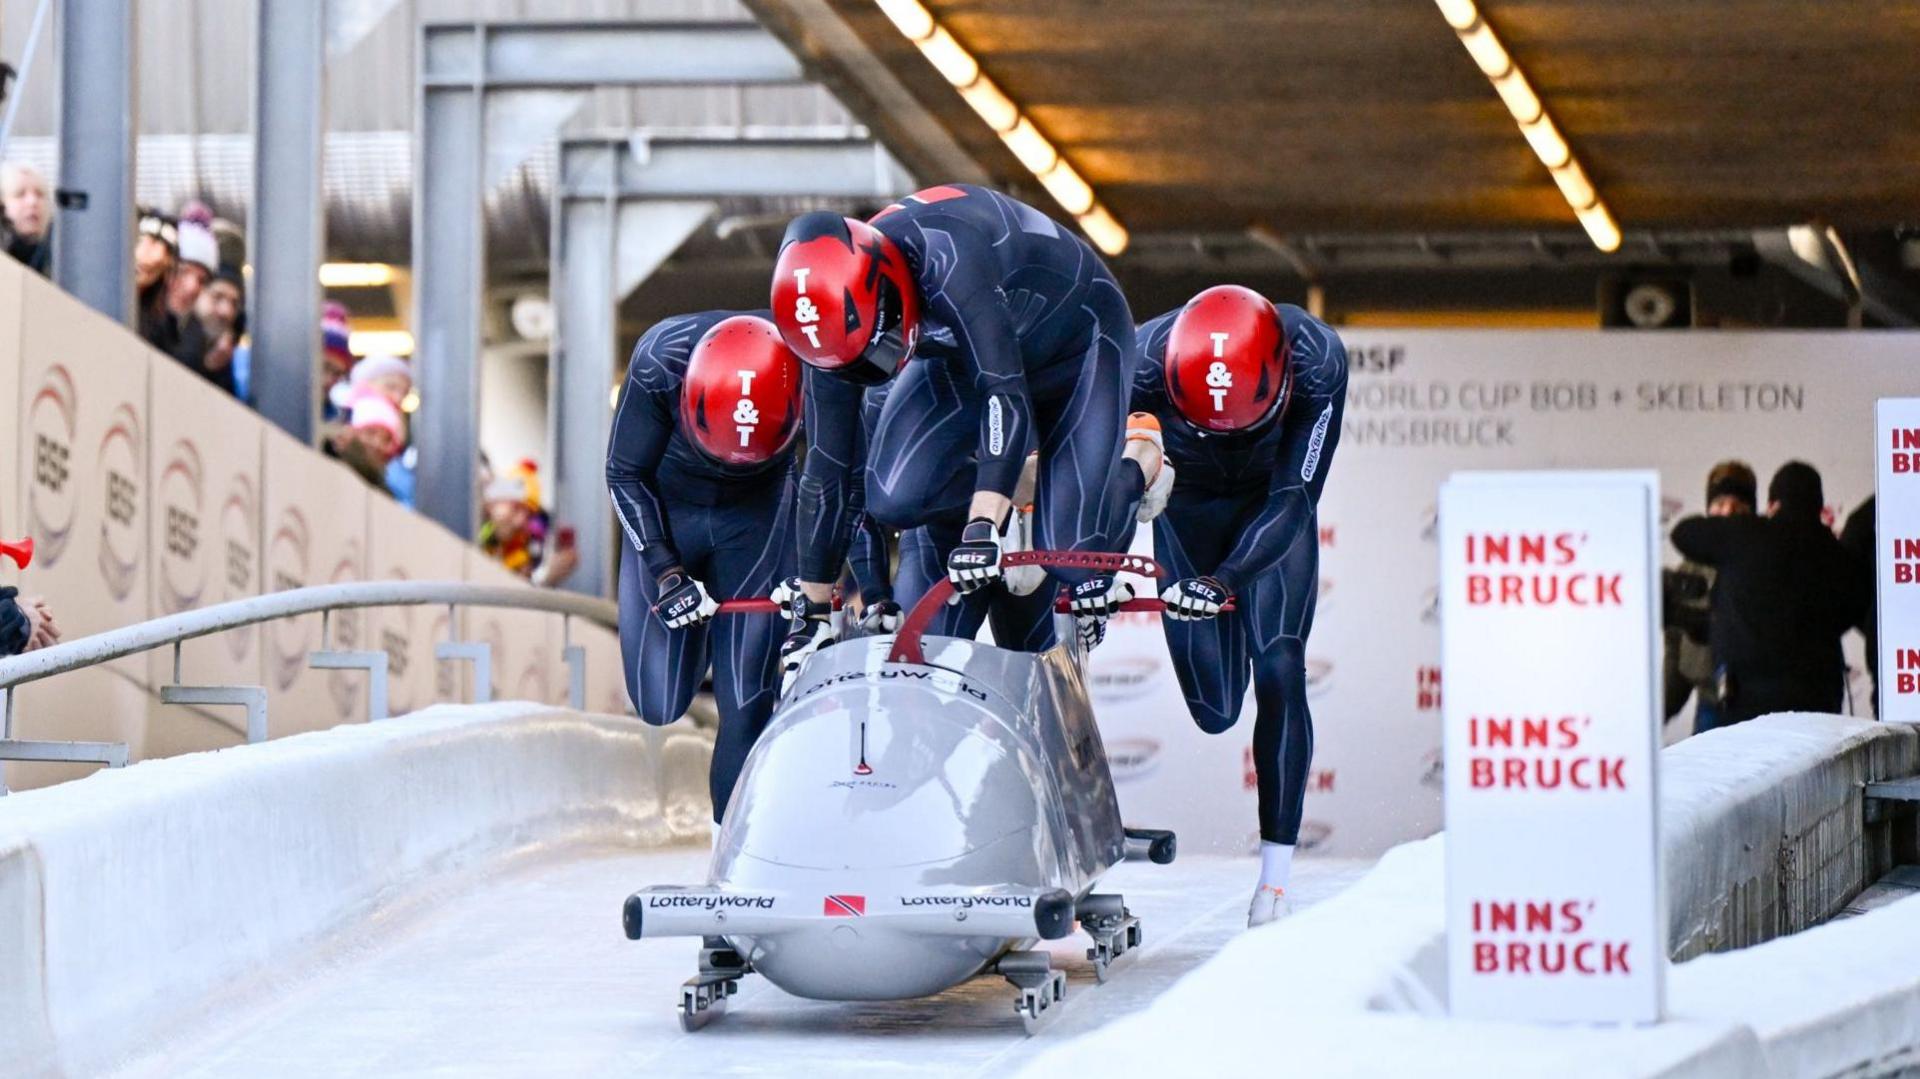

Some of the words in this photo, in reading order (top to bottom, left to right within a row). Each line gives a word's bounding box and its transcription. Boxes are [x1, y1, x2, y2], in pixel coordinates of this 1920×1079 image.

[793, 267, 820, 348] T&T
[1206, 332, 1233, 411] T&T
[1348, 346, 1405, 373] BSF
[732, 370, 759, 446] T&T
[1458, 382, 1520, 411] CUP
[1530, 383, 1597, 411] BOB
[1636, 383, 1804, 411] SKELETON
[1343, 417, 1514, 447] NNSBRUCK
[952, 553, 987, 565] SEIZ
[1075, 579, 1104, 595] SEIZ
[1188, 581, 1217, 600] SEIZ
[1465, 573, 1623, 607] BRUCK
[668, 595, 695, 617] SEIZ
[1470, 757, 1627, 790] BRUCK
[650, 896, 775, 910] LotteryWorld
[901, 896, 1031, 908] LotteryWorld
[1473, 940, 1631, 976] BRUCK
